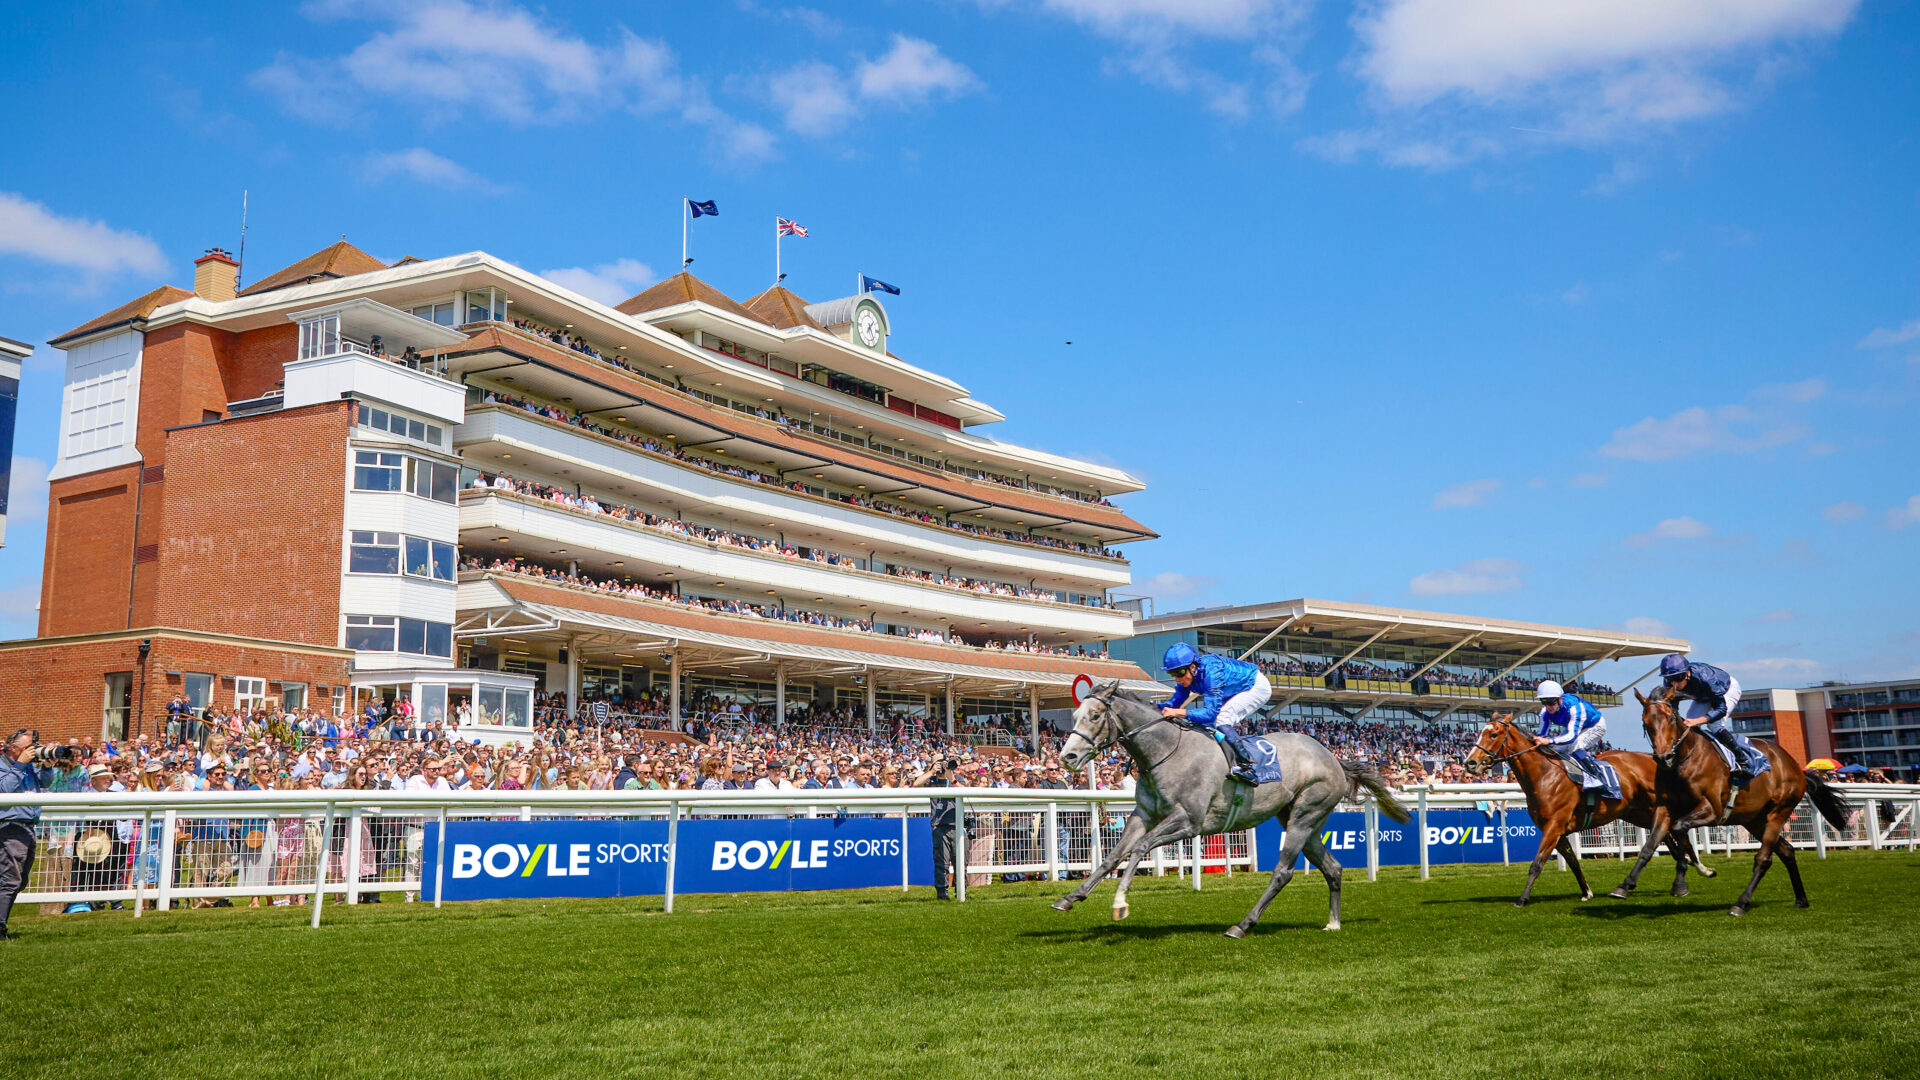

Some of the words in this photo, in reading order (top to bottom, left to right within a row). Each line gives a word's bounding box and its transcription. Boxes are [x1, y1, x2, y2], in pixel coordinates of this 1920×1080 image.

[1256, 740, 1276, 766] 9
[1599, 764, 1620, 788] 11
[1280, 831, 1356, 851] YLE
[1358, 830, 1403, 843] SORTS
[1427, 826, 1494, 845] BOYLE
[1496, 825, 1537, 838] SPORTS
[452, 843, 591, 879] BOYLE
[595, 843, 670, 864] SPORTS
[712, 840, 828, 871] BOYLE
[832, 839, 900, 857] SPORTS
